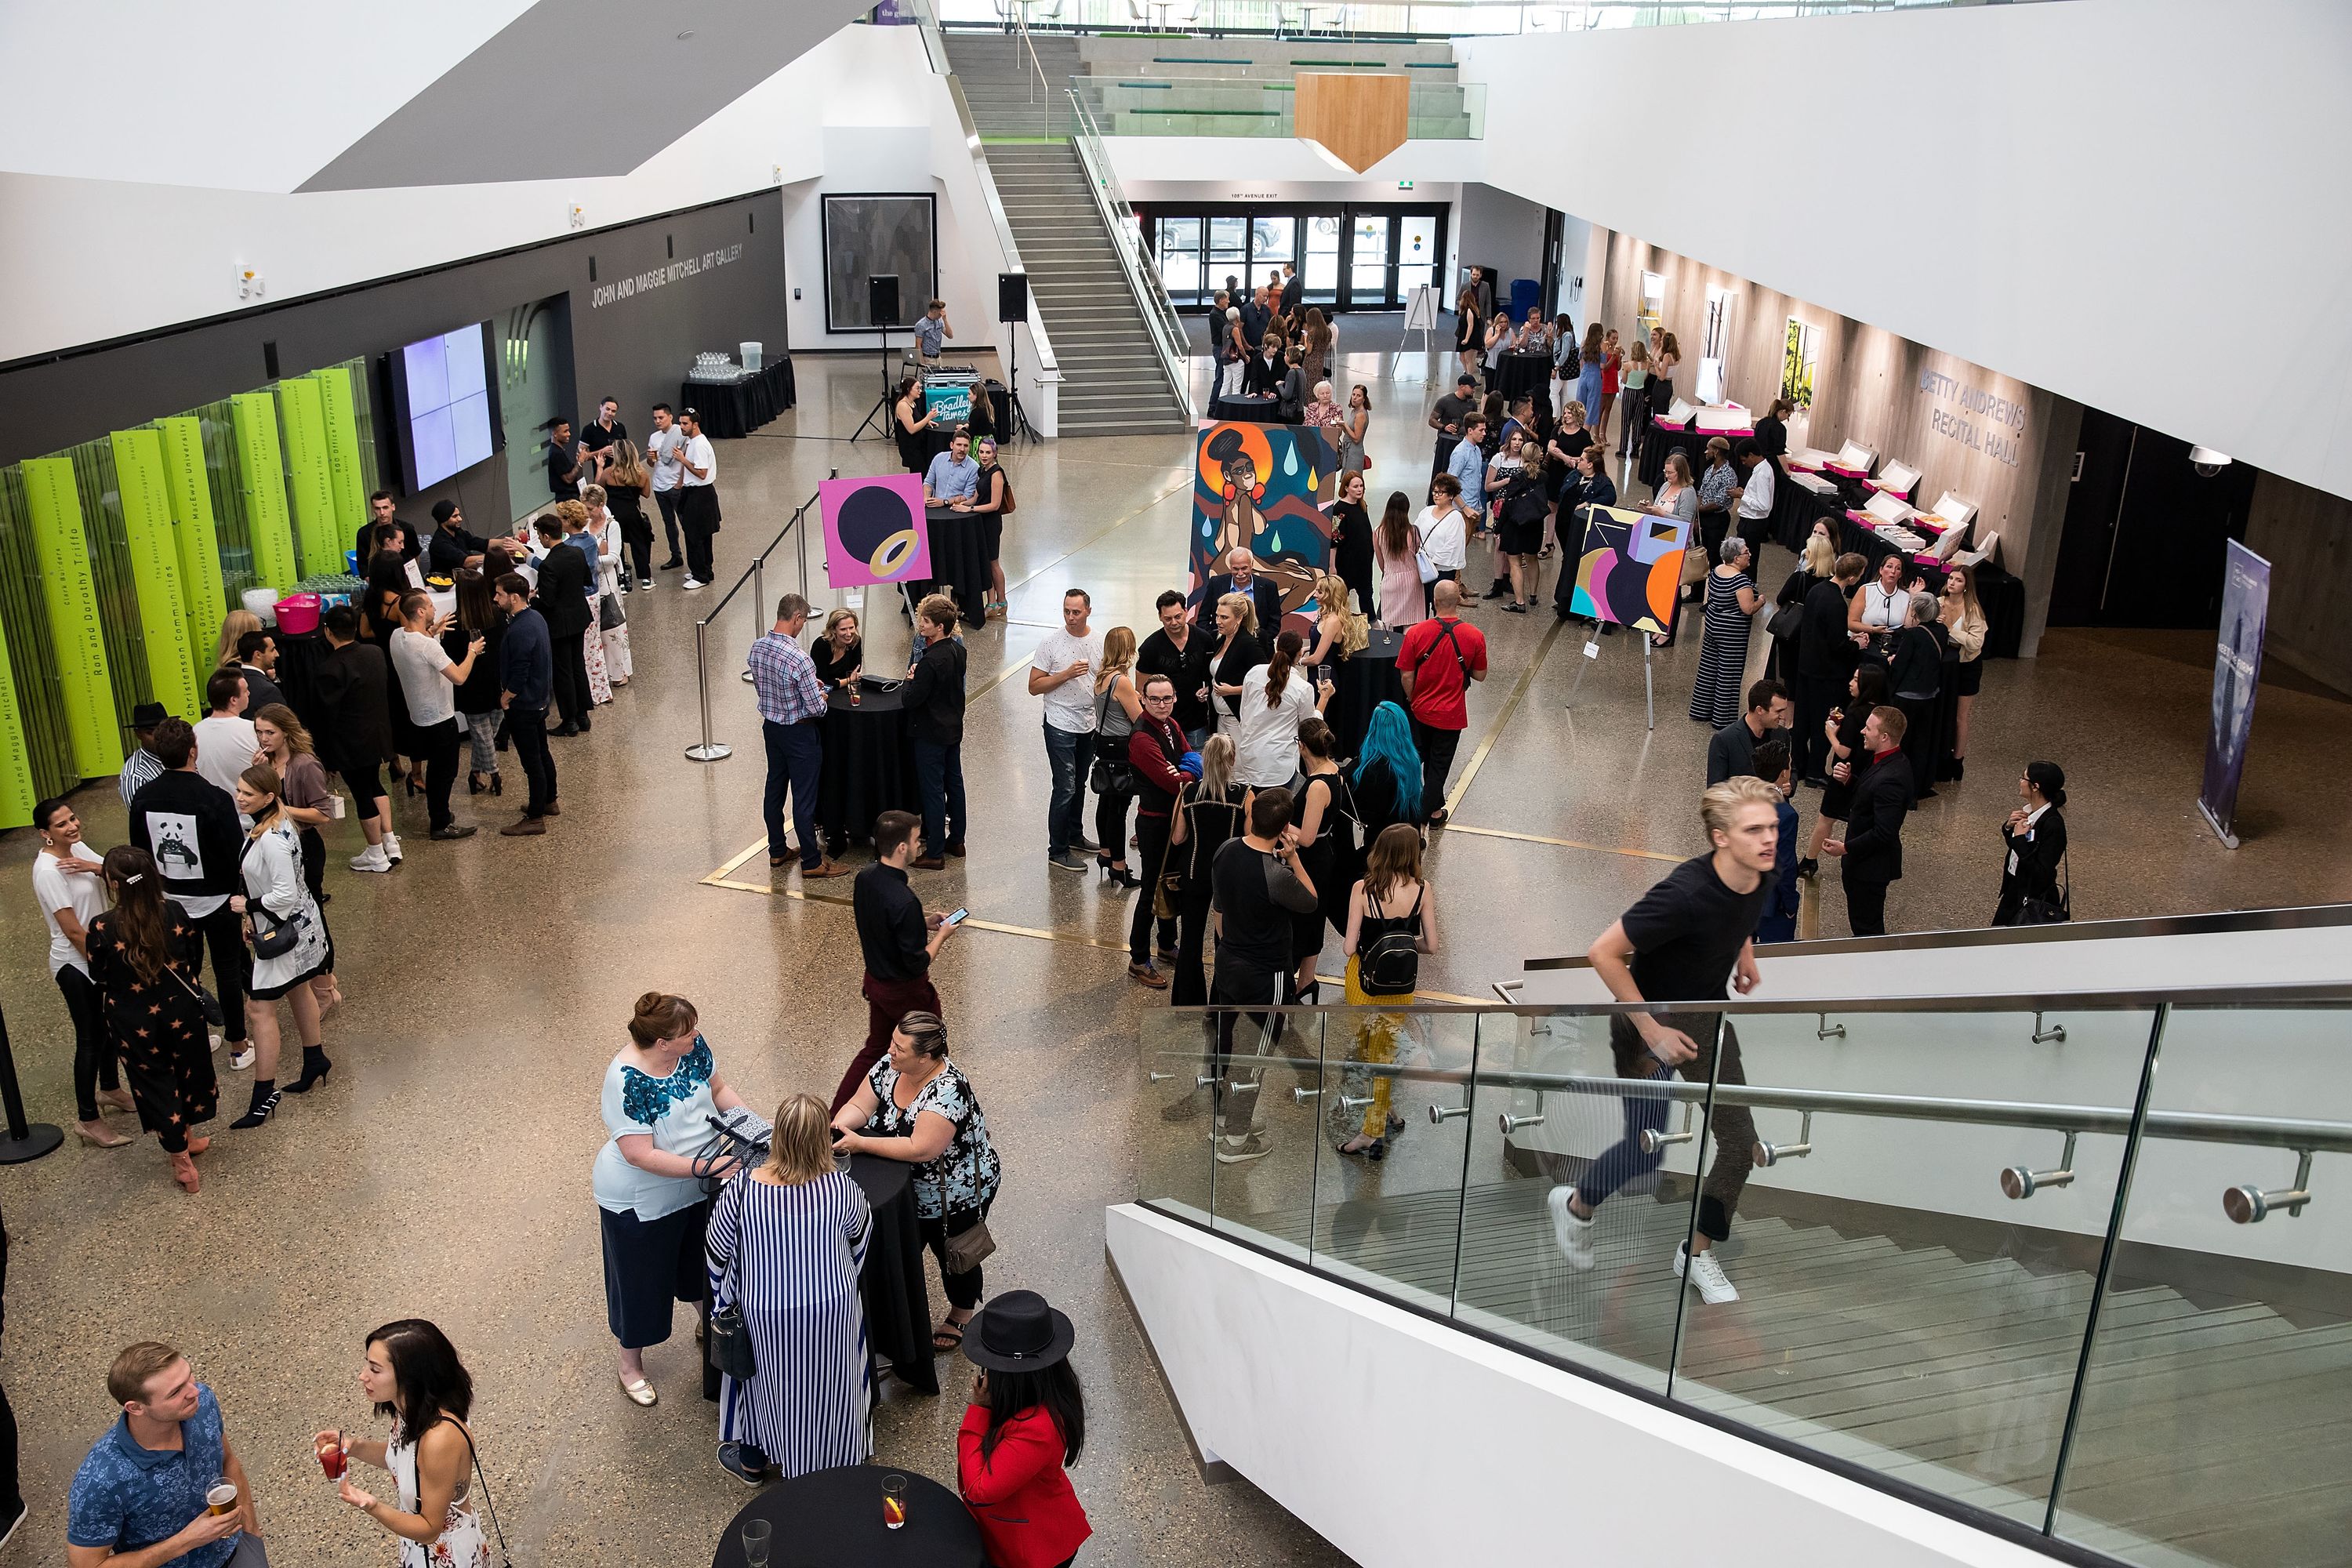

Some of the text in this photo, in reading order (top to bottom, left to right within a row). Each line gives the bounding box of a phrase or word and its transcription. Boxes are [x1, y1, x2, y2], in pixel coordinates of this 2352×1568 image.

[592, 243, 743, 309] JOHN AND MAGGIE MITCHELL ART GALLERY
[325, 375, 335, 425] Furnishings
[935, 394, 972, 413] Bradley
[1921, 368, 2027, 431] BETTY ANDREWS
[1931, 408, 2019, 468] RECITAL HALL
[318, 471, 327, 505] Landrex
[180, 423, 217, 635] Students Association of MacEwan University
[273, 532, 281, 562] Canada
[56, 547, 70, 606] Clark Builders
[70, 527, 103, 677] Ron and Dorothy Triffo
[165, 565, 195, 717] Christenson Communities
[198, 600, 212, 667] TD Bank Group
[0, 676, 30, 812] John and Maggie Mitchell
